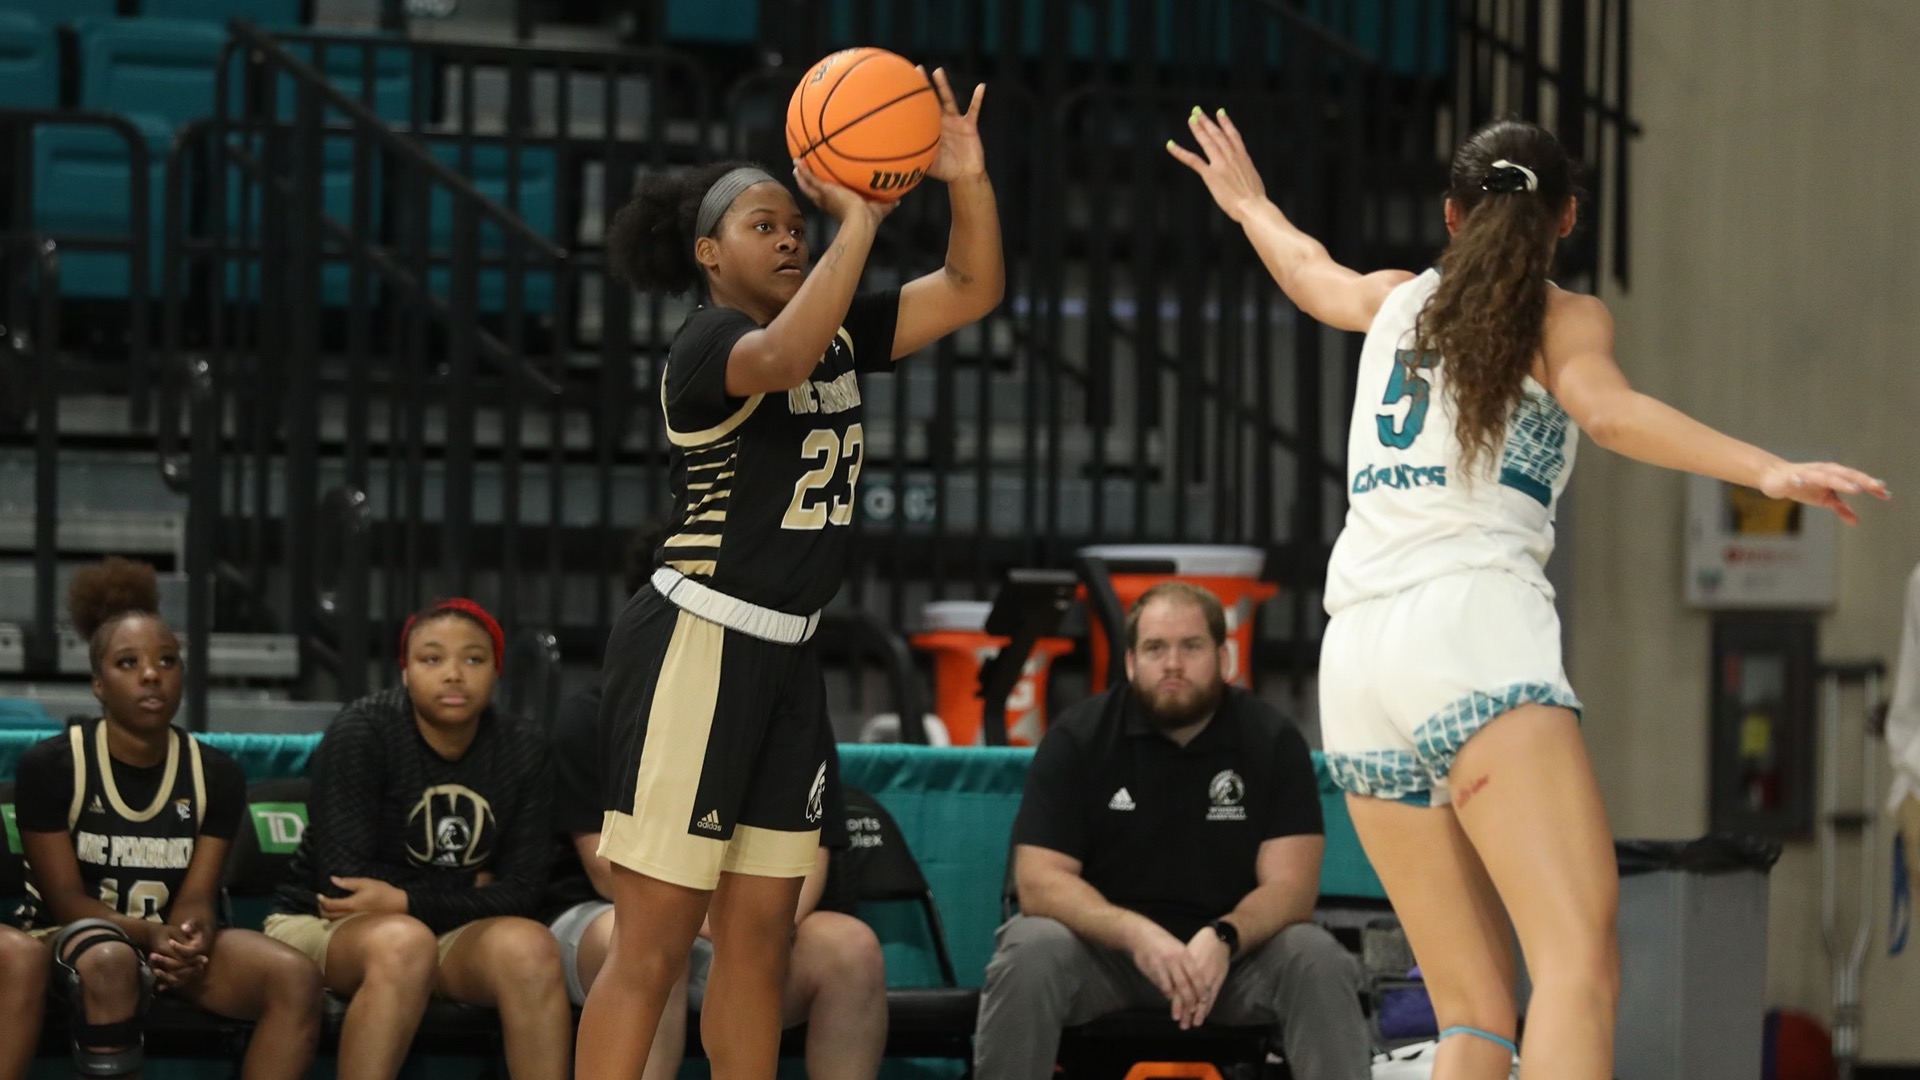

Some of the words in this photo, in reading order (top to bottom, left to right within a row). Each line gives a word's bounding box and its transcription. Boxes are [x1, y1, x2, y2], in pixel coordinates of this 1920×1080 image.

[870, 166, 927, 190] Wil
[1376, 348, 1442, 450] 5
[780, 422, 865, 530] 23
[256, 811, 305, 843] TD
[696, 820, 722, 832] adidas
